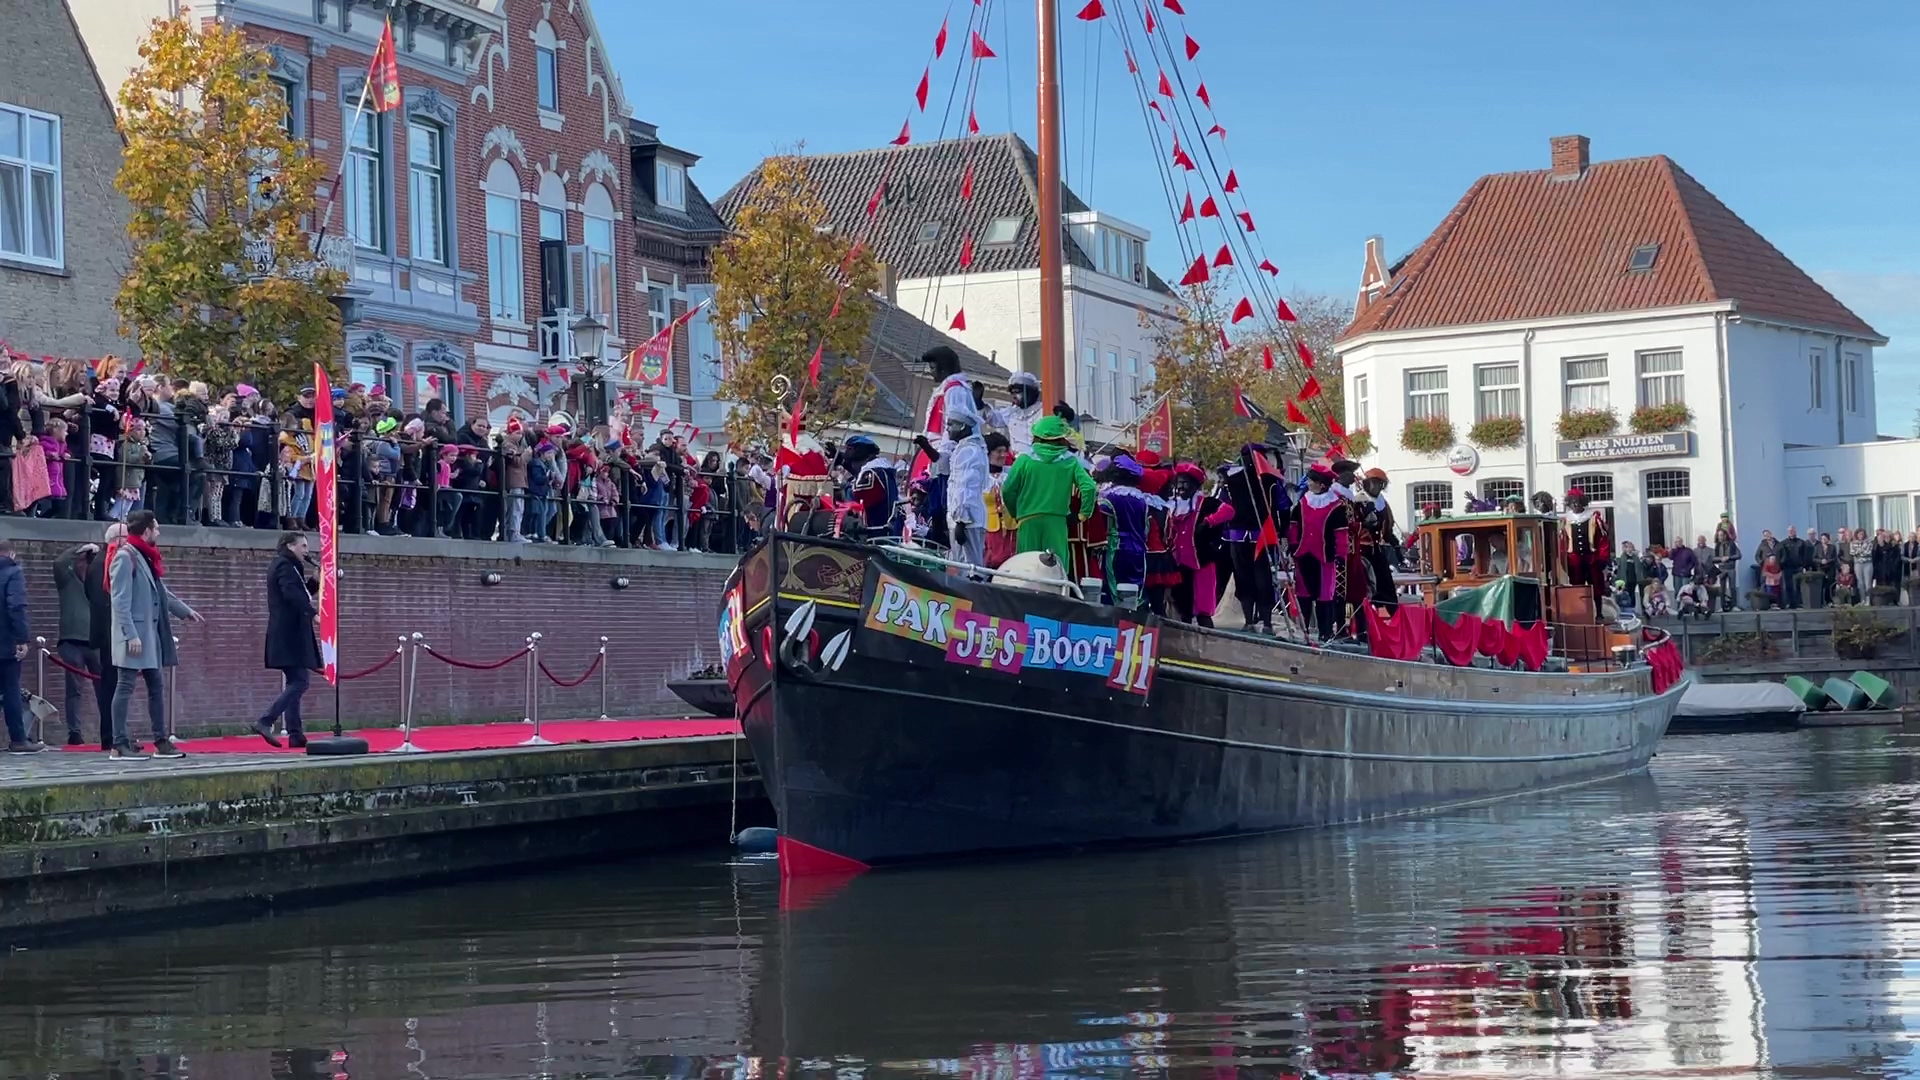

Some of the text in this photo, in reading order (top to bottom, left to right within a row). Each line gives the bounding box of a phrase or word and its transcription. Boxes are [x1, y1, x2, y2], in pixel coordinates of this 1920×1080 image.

[874, 581, 1154, 691] PAK JES BOOT 11
